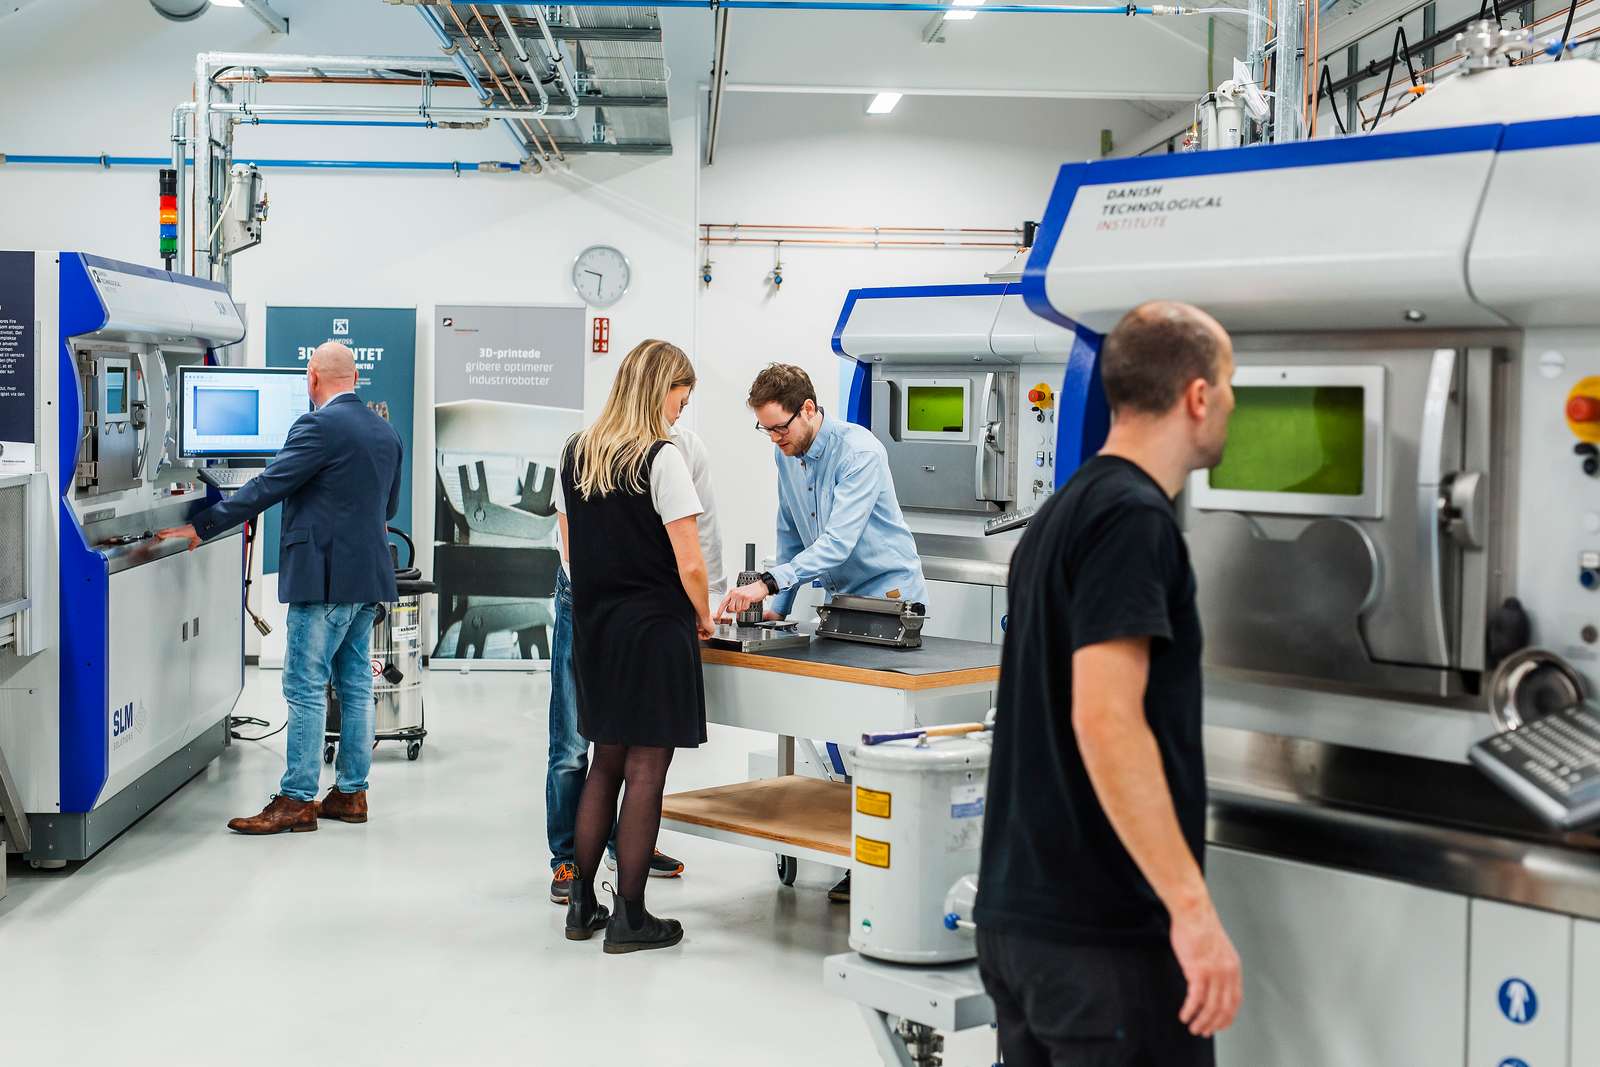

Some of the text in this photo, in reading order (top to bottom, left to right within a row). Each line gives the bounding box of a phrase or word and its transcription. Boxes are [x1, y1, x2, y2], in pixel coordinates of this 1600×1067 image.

[1106, 186, 1163, 200] DANISH
[1102, 197, 1222, 216] TECHNOLOGICAL
[1095, 215, 1167, 232] INSTITUTE
[479, 347, 541, 359] 3D-printede
[465, 360, 554, 373] gribere optimerer
[469, 375, 550, 386] industrirobotter
[113, 702, 133, 737] SLM
